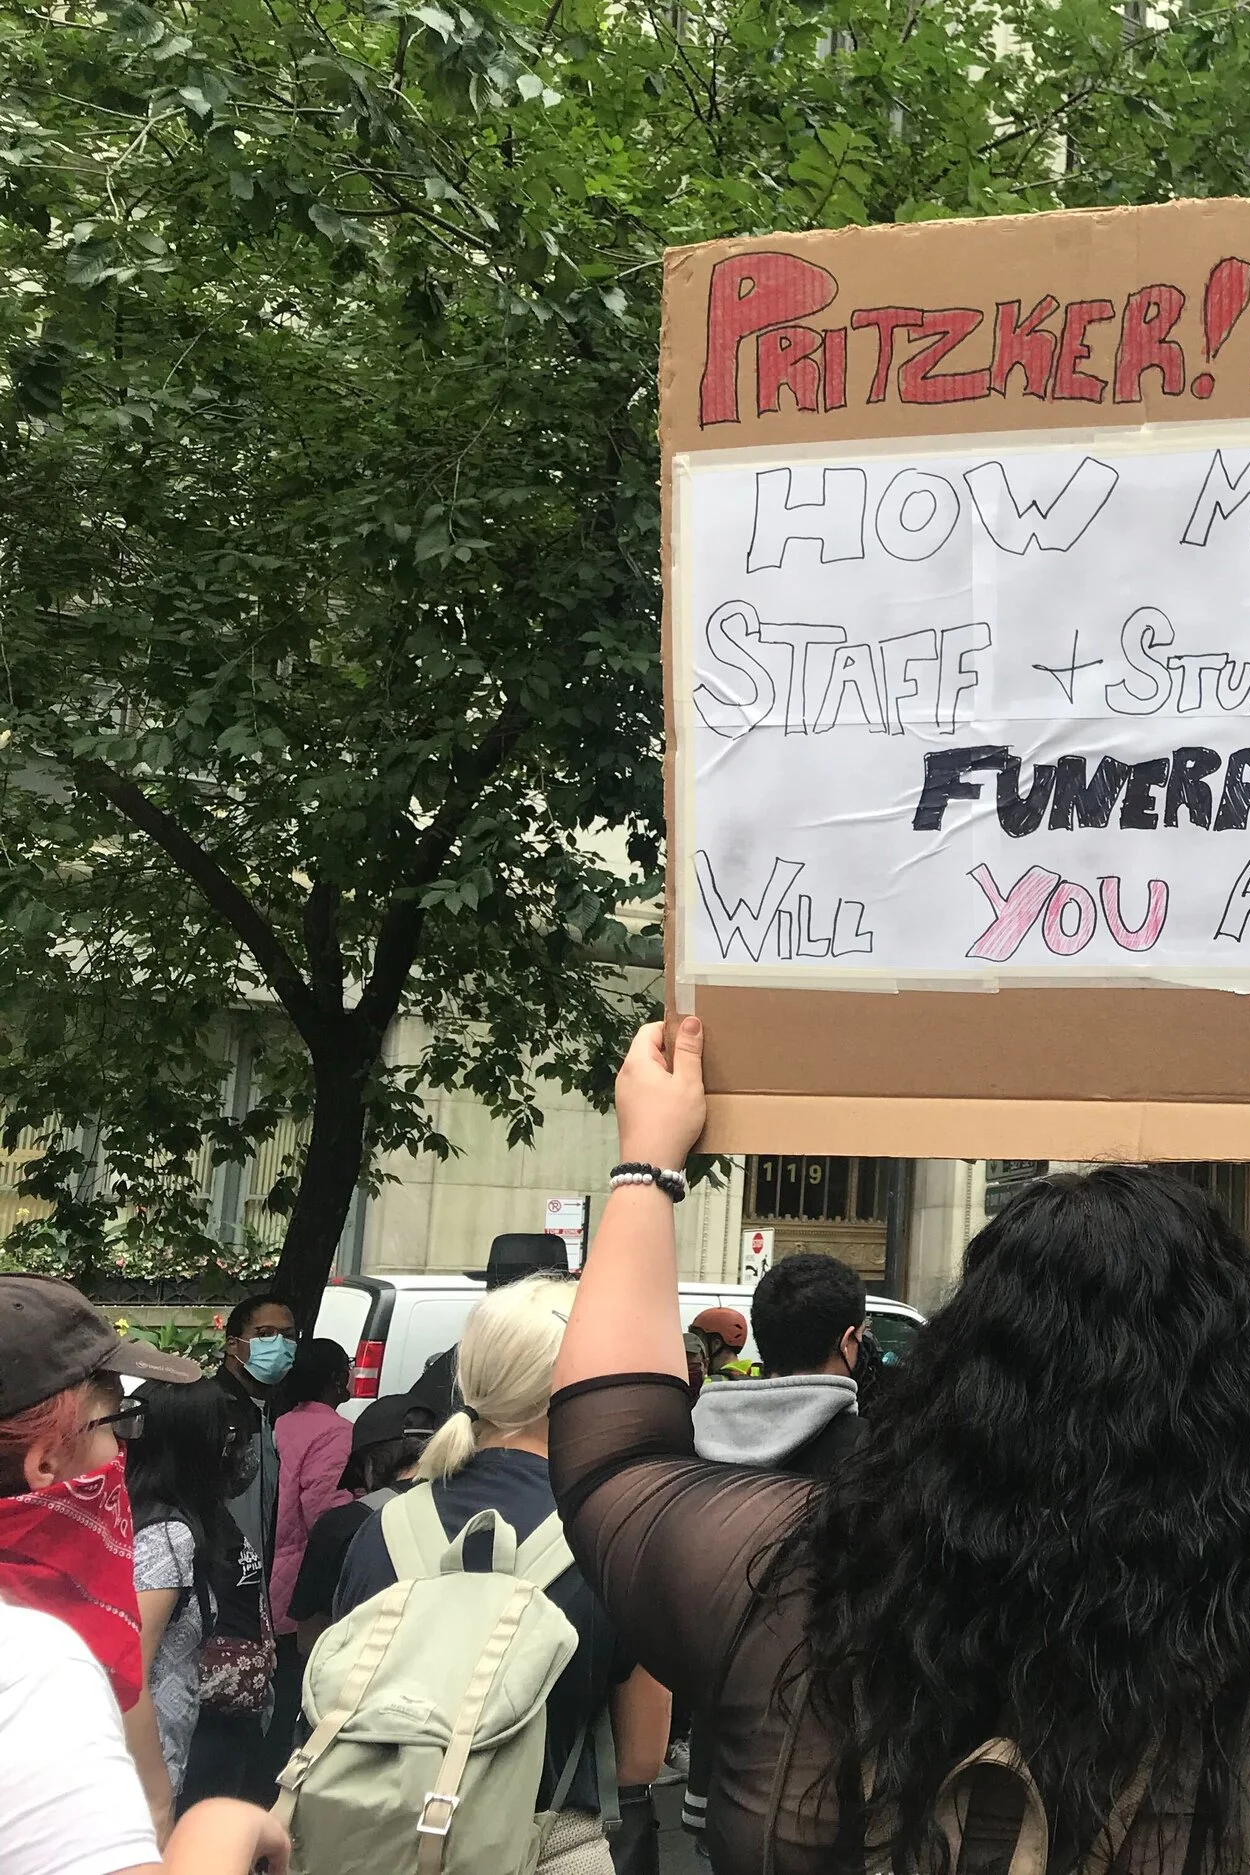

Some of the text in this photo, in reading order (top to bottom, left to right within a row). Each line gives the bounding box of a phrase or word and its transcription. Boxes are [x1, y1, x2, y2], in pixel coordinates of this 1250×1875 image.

[746, 456, 1120, 574] HOW
[692, 599, 992, 741] STAFF
[1032, 629, 1104, 704] +
[690, 850, 874, 962] WILL
[966, 862, 1170, 963] YOU
[763, 1161, 823, 1185] 119
